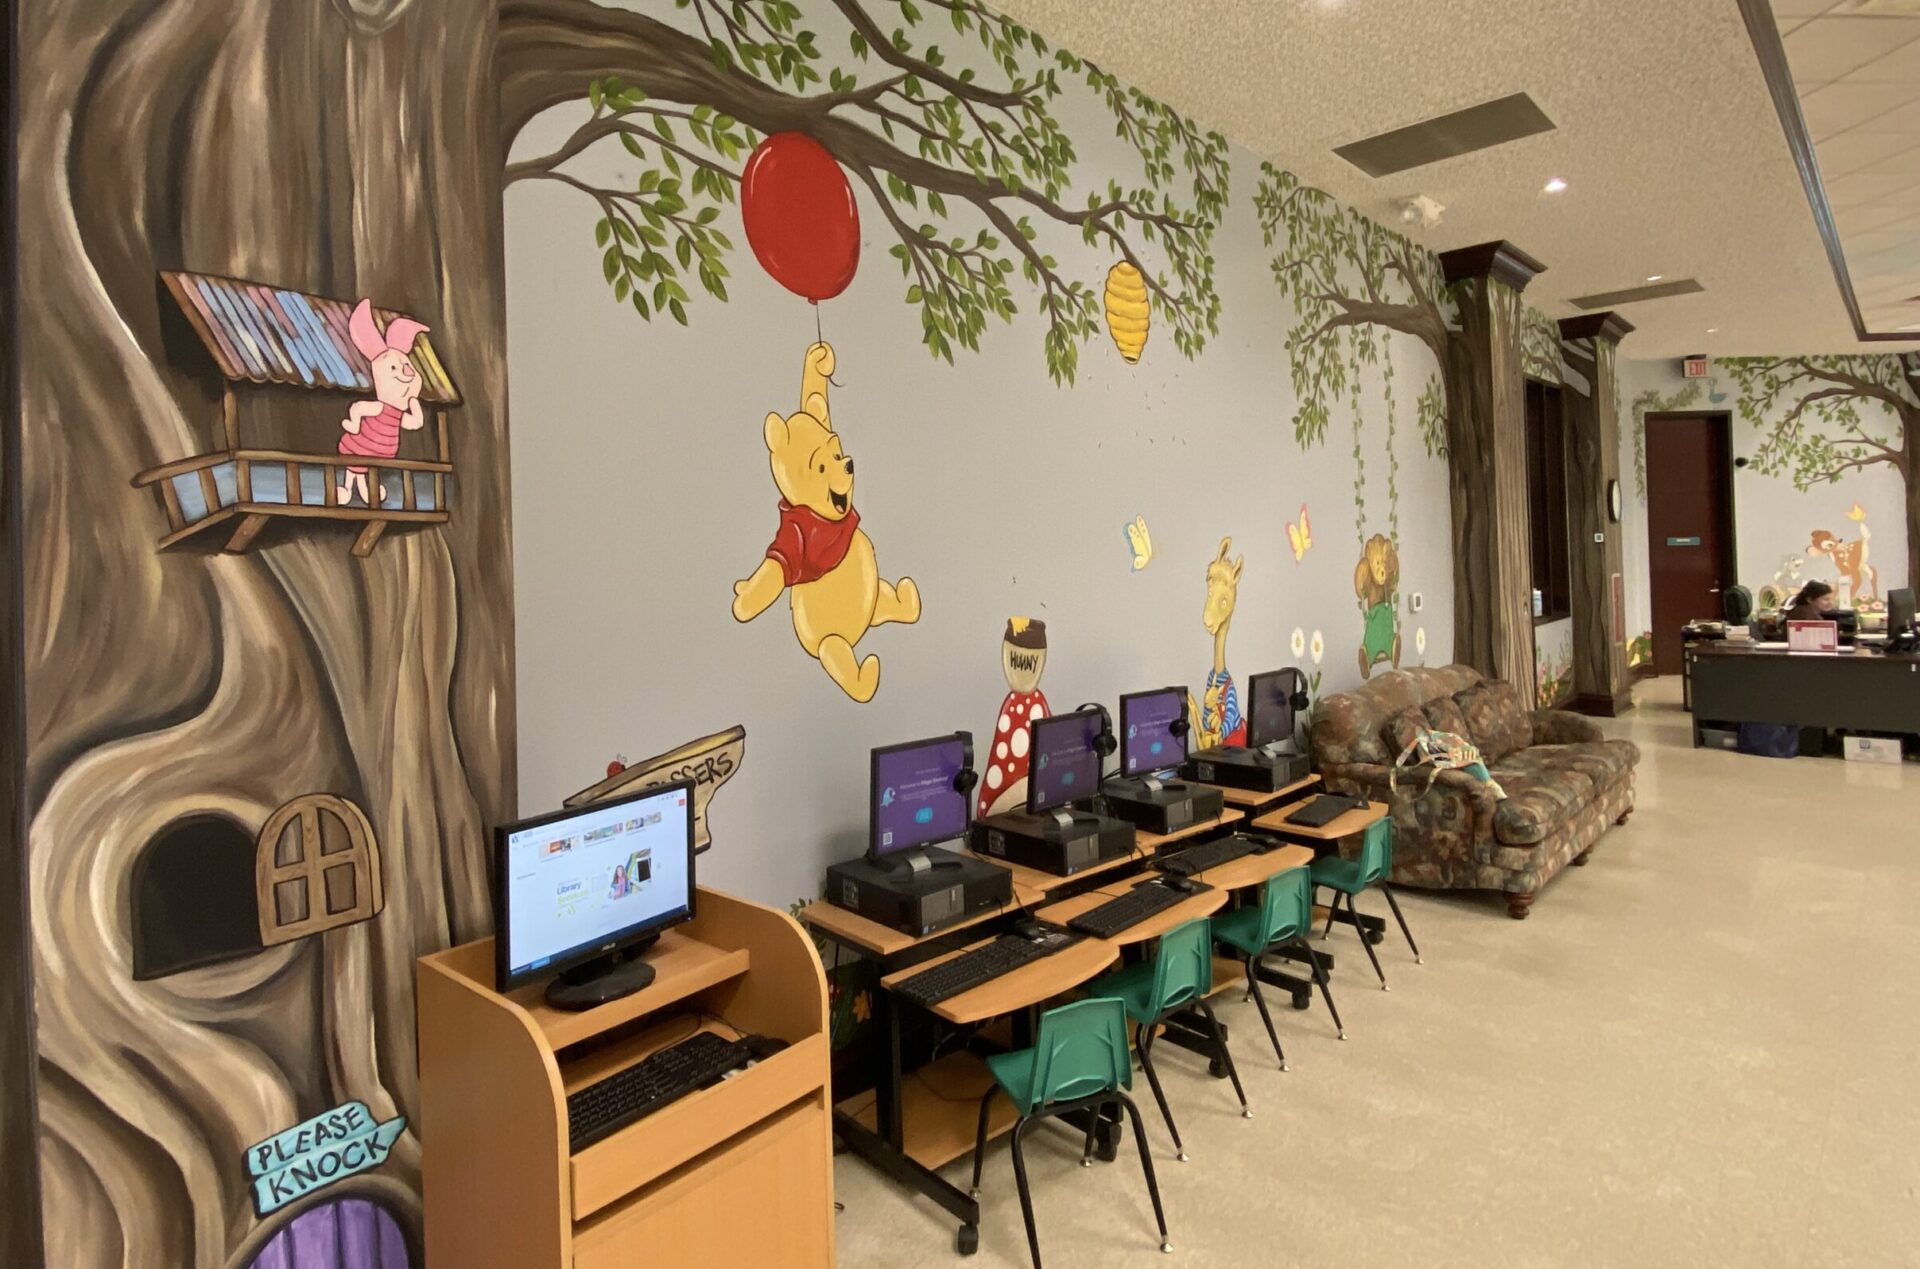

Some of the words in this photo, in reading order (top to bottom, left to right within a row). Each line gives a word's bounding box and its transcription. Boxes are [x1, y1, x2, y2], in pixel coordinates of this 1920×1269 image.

[1689, 361, 1707, 376] EXIT
[1010, 650, 1039, 674] HUNNY
[646, 752, 733, 786] SERS
[557, 881, 583, 896] Library
[257, 1106, 364, 1171] PLEASE
[269, 1132, 387, 1204] KNOCK
